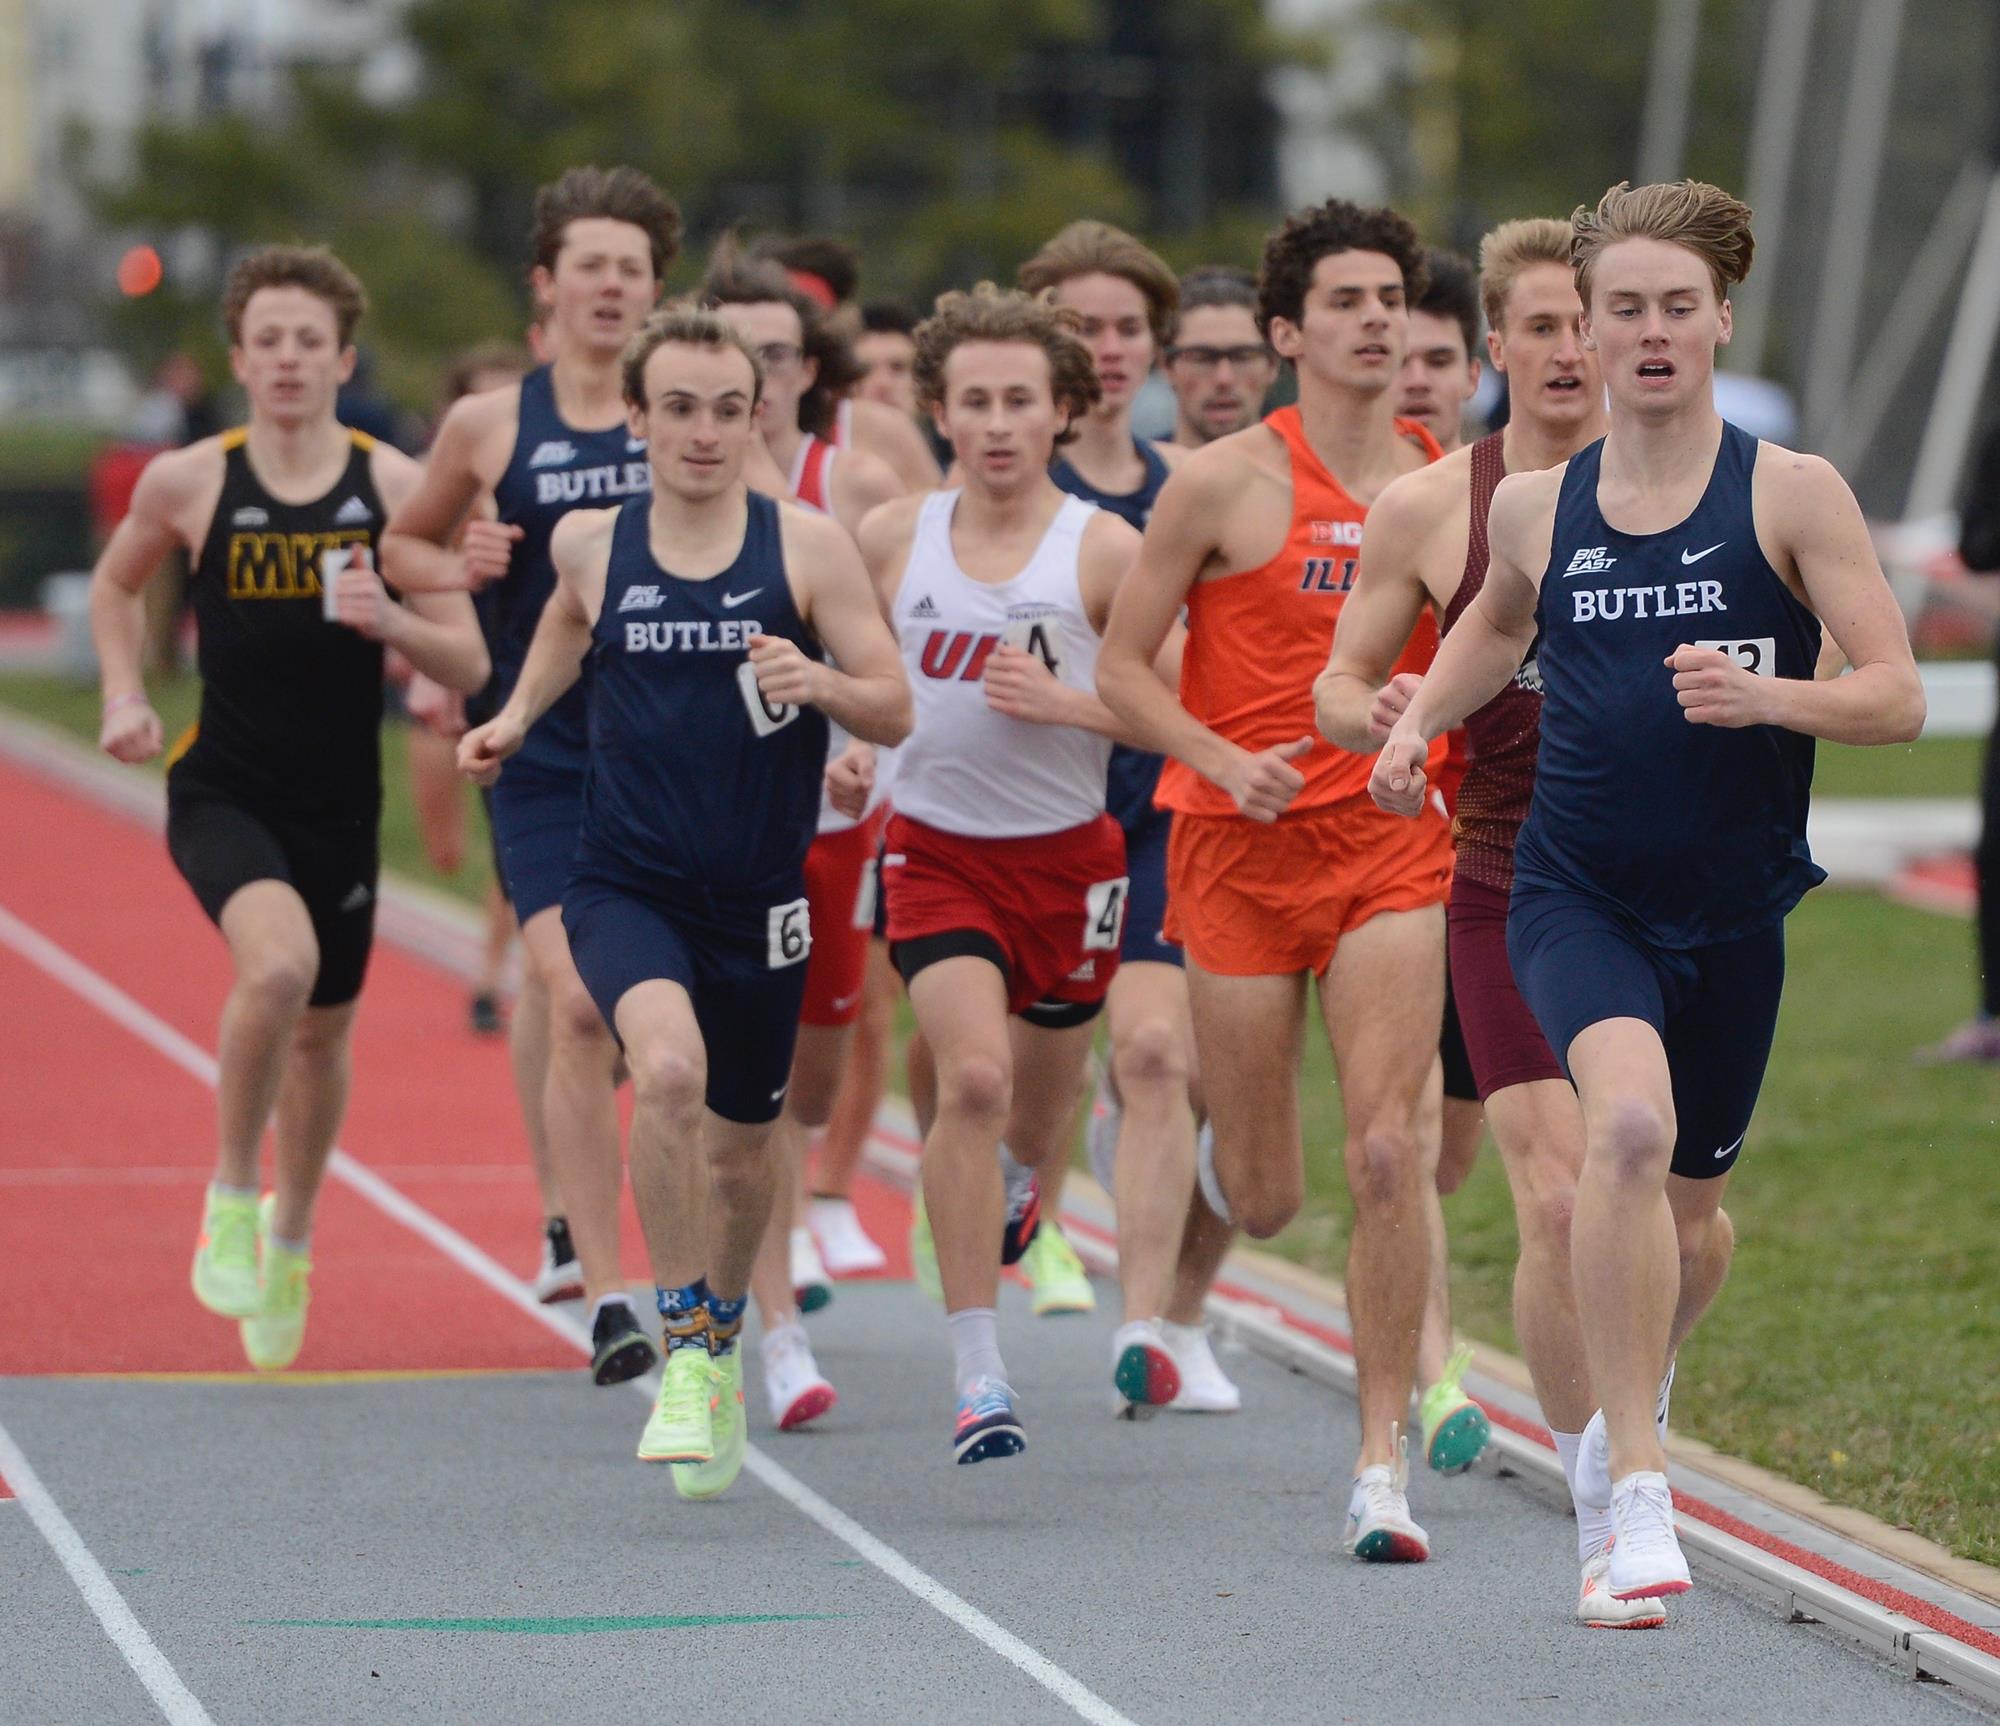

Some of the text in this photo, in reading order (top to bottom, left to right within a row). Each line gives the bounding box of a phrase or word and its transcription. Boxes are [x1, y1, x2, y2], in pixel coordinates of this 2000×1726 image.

[537, 462, 653, 504] BUTLE
[1565, 558, 1618, 572] EAST
[1572, 546, 1608, 561] BIG
[1572, 580, 1727, 622] BUTLER
[781, 907, 804, 960] 6
[1097, 886, 1120, 944] 4
